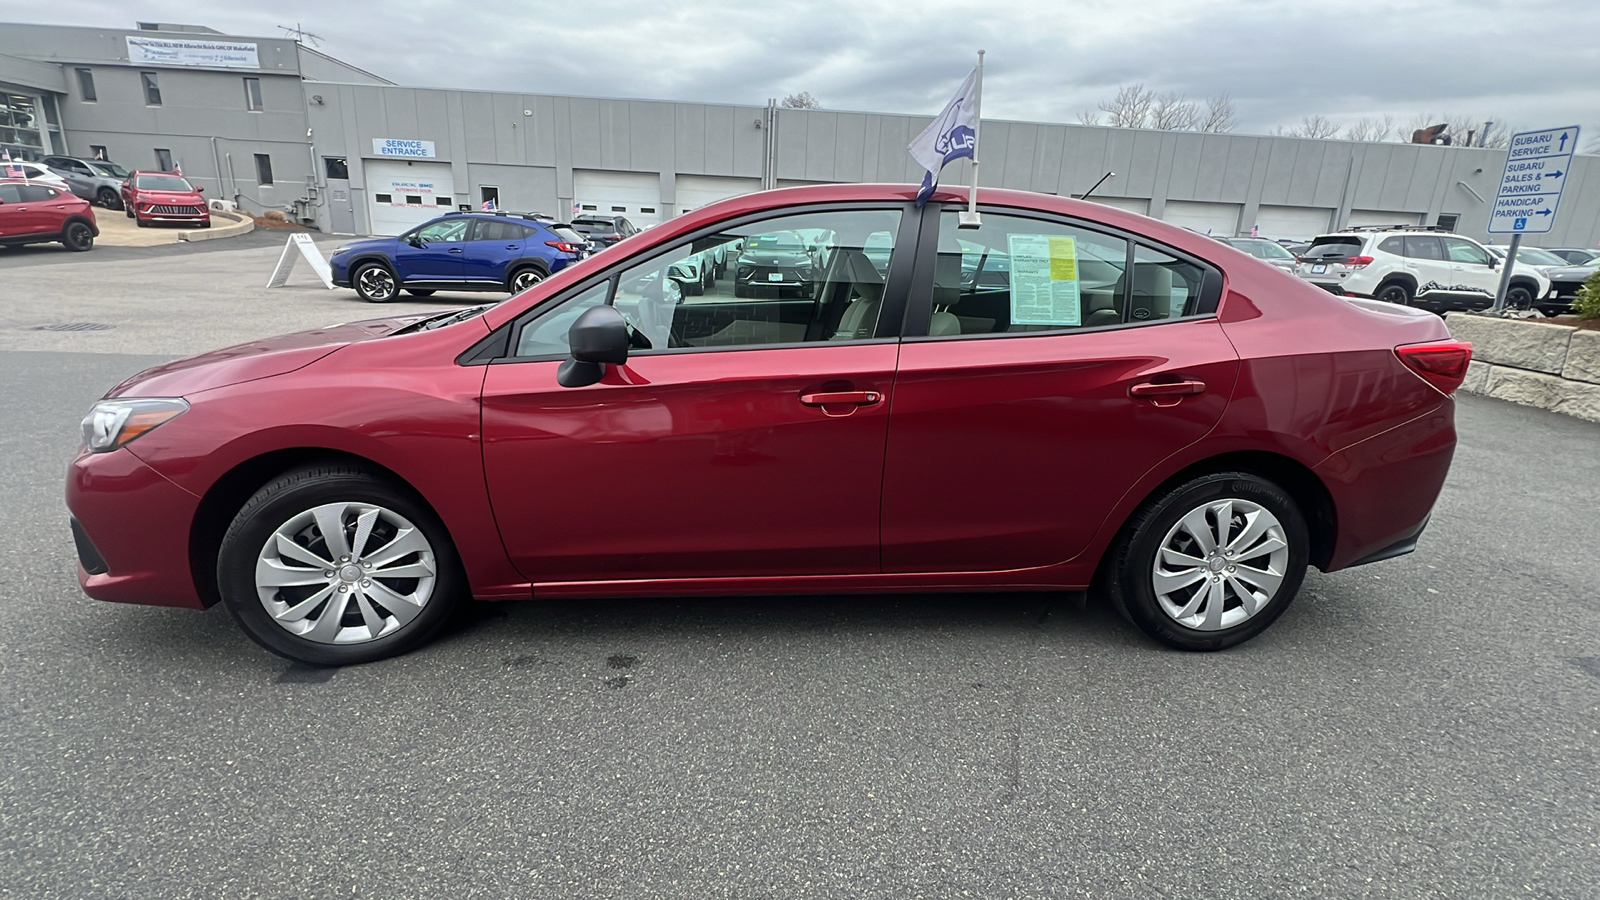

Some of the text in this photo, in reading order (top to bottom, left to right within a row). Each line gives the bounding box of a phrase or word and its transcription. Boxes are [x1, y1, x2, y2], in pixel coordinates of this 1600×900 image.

[386, 140, 422, 148] SERVICE
[1514, 134, 1552, 146] SUBARU
[382, 147, 427, 156] ENTRANCE
[1512, 146, 1550, 157] SERVICE
[1507, 162, 1545, 172] SUBARU
[1504, 174, 1533, 183] SALES
[1501, 184, 1541, 194] PARKING
[1498, 198, 1544, 207] HANDICAP
[1495, 209, 1534, 218] PARKING
